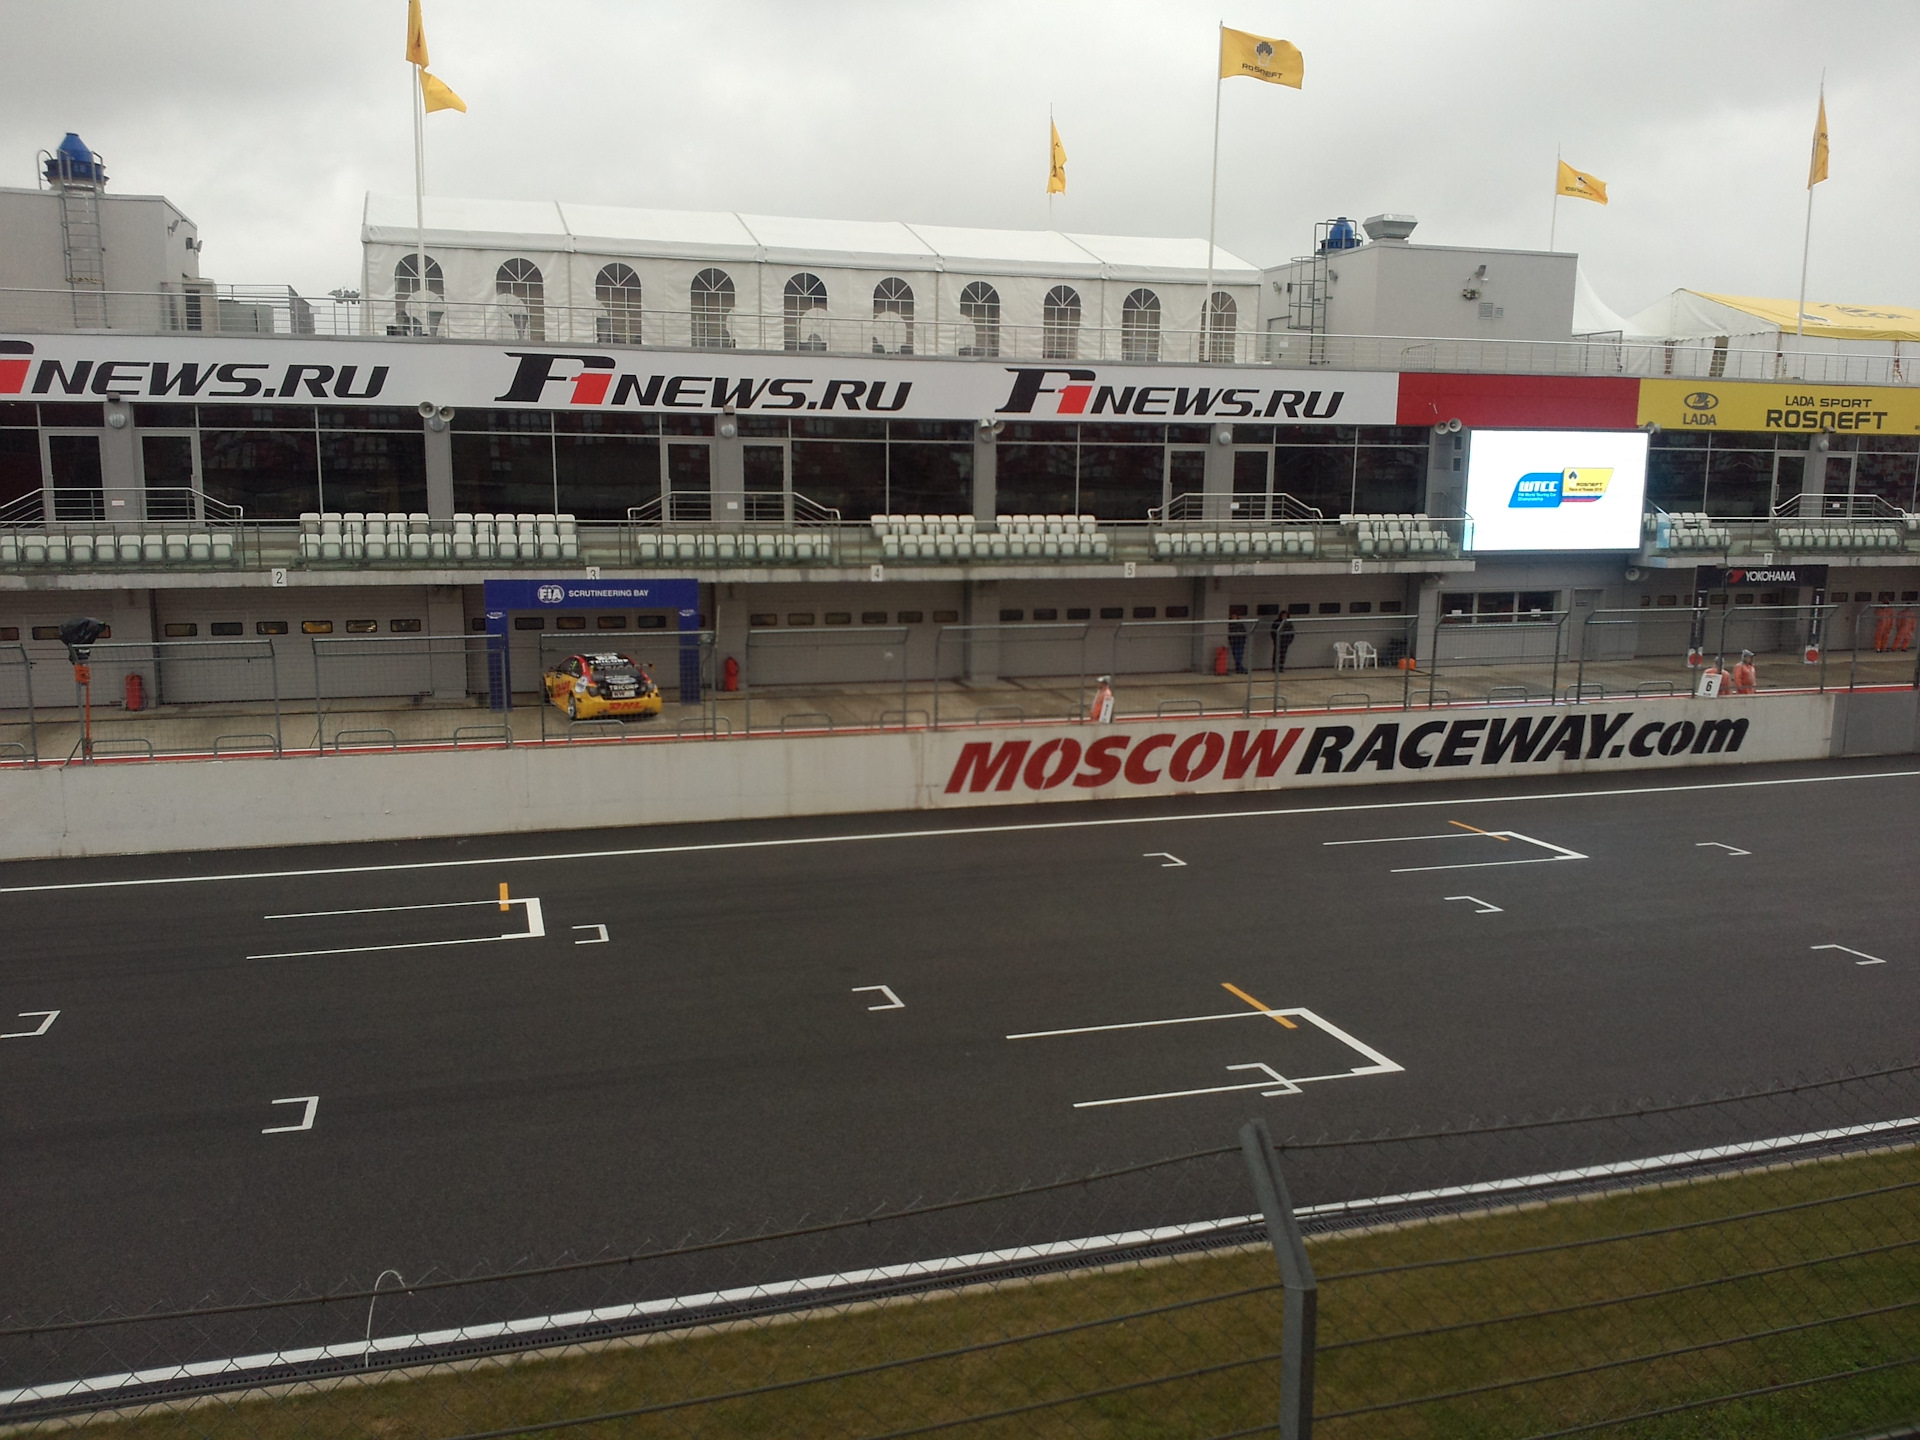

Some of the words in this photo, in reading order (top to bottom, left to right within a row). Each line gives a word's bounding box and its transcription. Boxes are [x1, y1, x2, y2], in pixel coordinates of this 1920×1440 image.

[1242, 63, 1283, 79] ROSNEFT
[1785, 395, 1815, 407] LADA
[1820, 398, 1872, 408] SPORT
[1682, 413, 1717, 426] LADA
[1766, 409, 1888, 430] ROSNEFT
[1518, 481, 1559, 492] WTCC
[1127, 567, 1133, 575] 5
[1354, 562, 1360, 571] 6
[276, 571, 283, 584] 2
[590, 569, 596, 579] 3
[874, 570, 880, 578] 4
[1745, 570, 1796, 582] YOKOHAMA
[568, 588, 632, 598] SCRUTINEERING
[633, 588, 649, 597] BAY
[608, 683, 639, 691] TRICORP
[1705, 680, 1714, 692] 6
[609, 702, 642, 710] DHL
